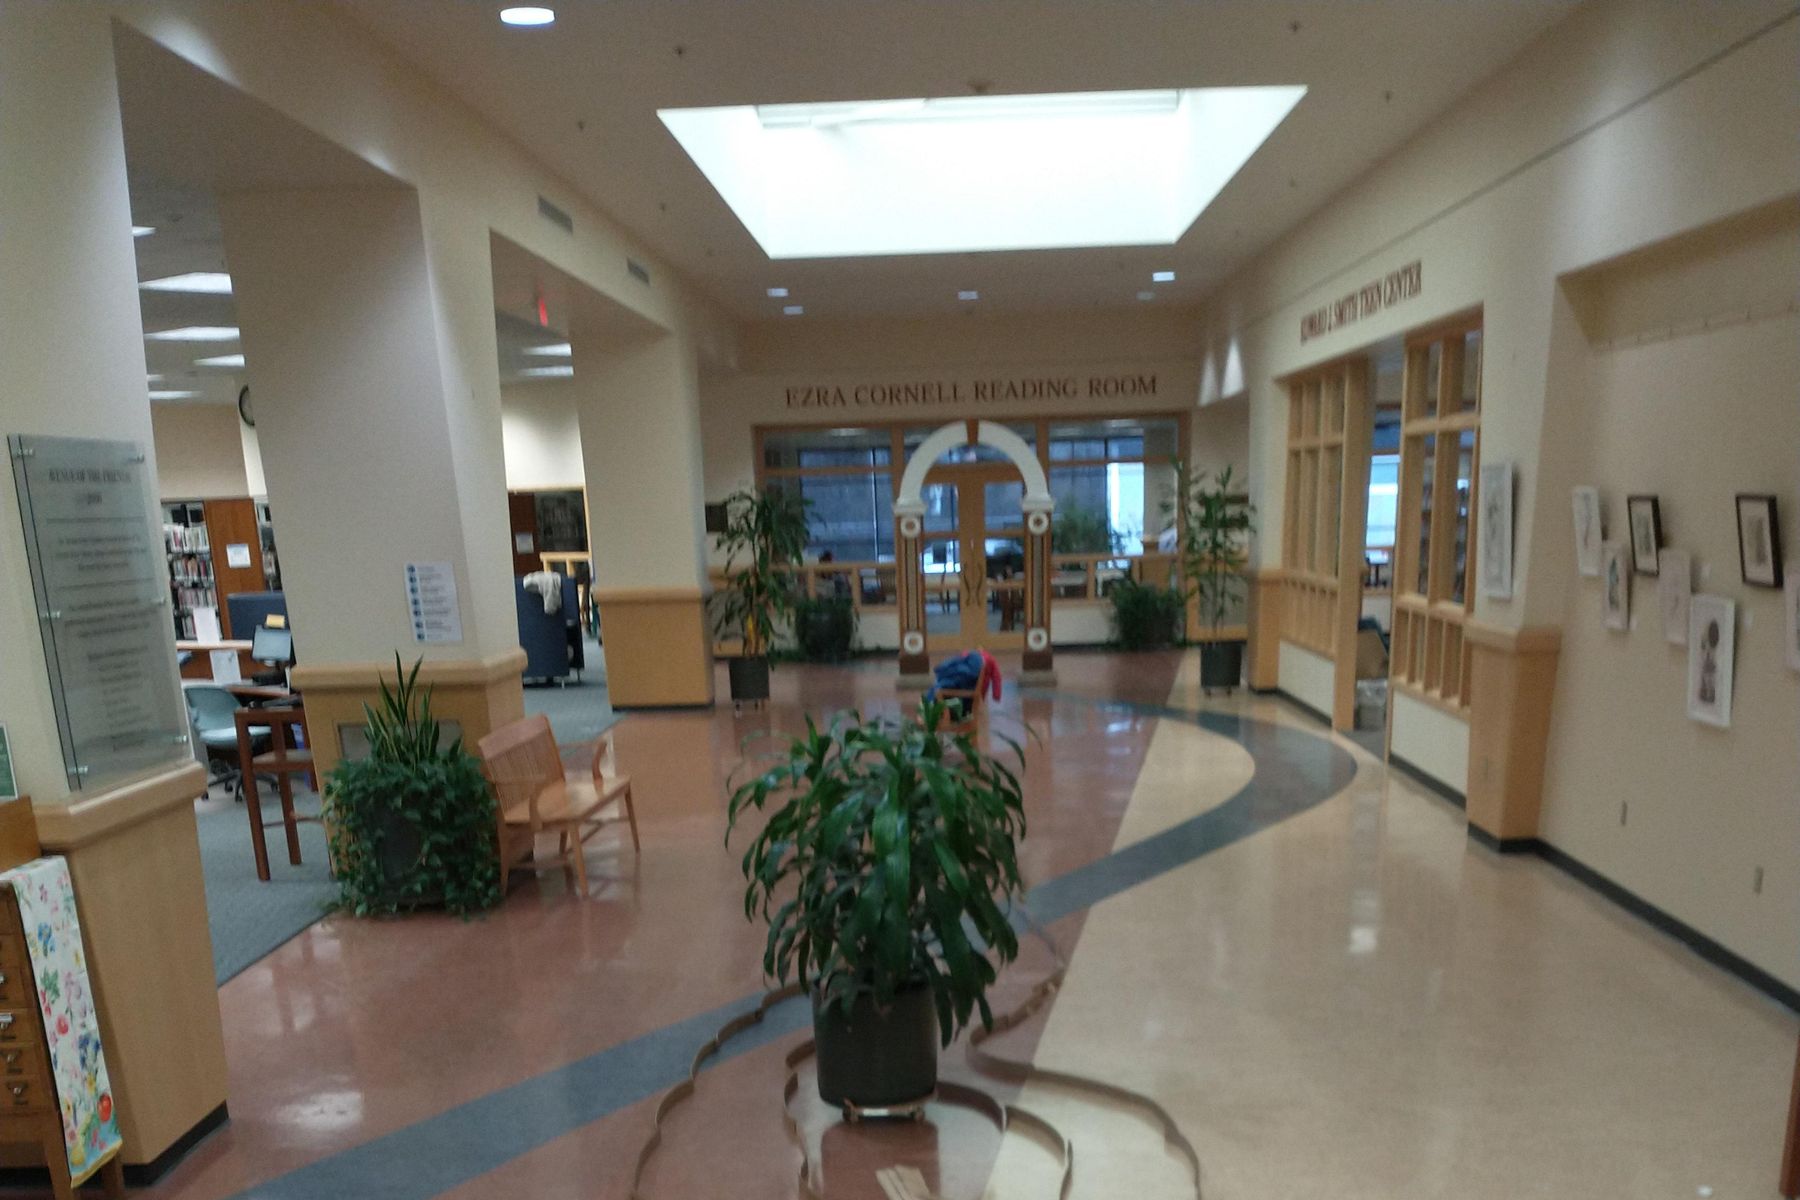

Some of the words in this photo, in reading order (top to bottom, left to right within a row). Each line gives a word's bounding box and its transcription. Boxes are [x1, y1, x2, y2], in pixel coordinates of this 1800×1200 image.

[1383, 259, 1422, 309] CENTER
[786, 385, 847, 408] EZRA
[854, 381, 966, 406] CORNELL
[974, 377, 1078, 401] READING
[1088, 374, 1157, 398] ROOM
